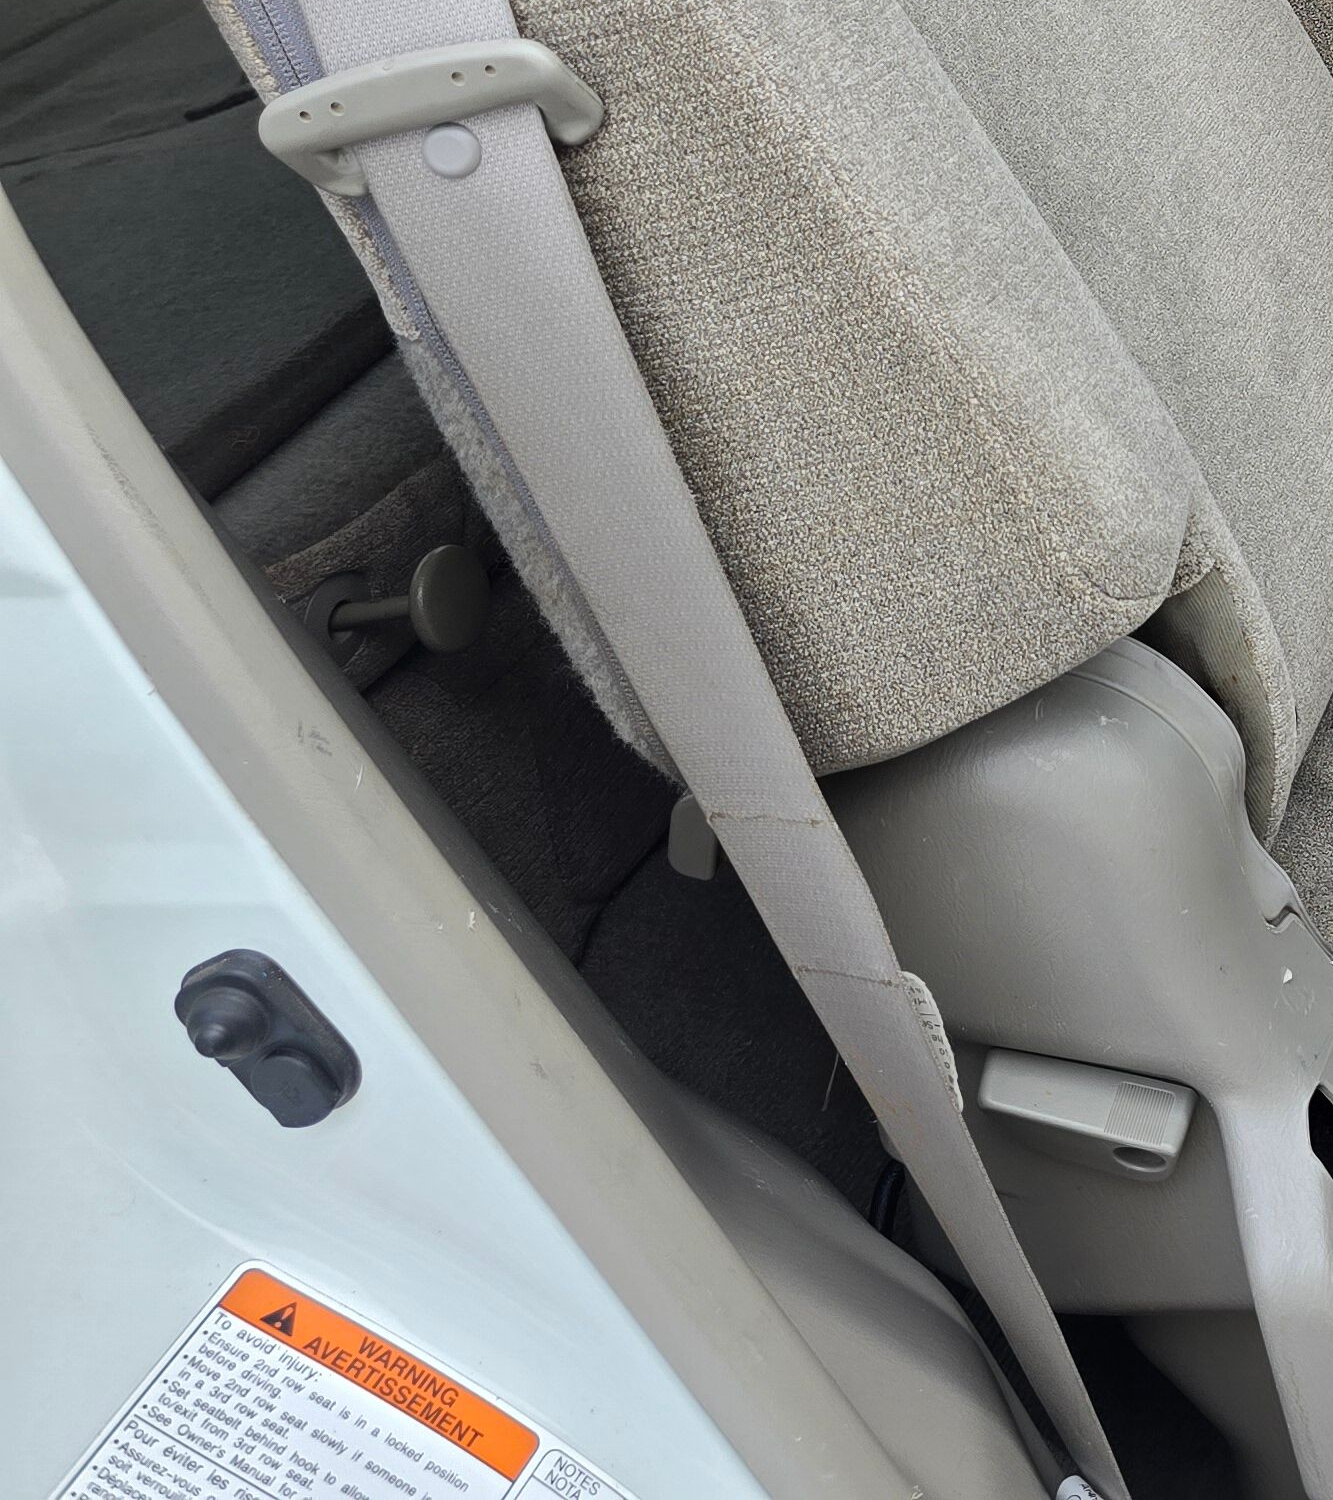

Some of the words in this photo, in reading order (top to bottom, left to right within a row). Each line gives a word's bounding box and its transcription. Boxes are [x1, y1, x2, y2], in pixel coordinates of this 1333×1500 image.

[197, 1342, 237, 1372] before
[240, 1369, 282, 1400] driving.
[213, 1311, 232, 1331] To
[236, 1330, 279, 1355] avoid
[278, 1349, 323, 1383] injury:
[358, 1336, 459, 1408] WARNING
[167, 1380, 191, 1401] Set
[192, 1398, 243, 1431] seatbelt
[243, 1425, 289, 1456] behind
[288, 1450, 321, 1476] hook
[322, 1471, 337, 1486] to
[177, 1366, 192, 1382] in
[194, 1379, 205, 1390] a
[208, 1385, 233, 1405] 3rd
[233, 1402, 259, 1420] row
[260, 1417, 290, 1440] seat.
[187, 1355, 222, 1382] Move
[223, 1378, 252, 1398] 2nd
[252, 1395, 277, 1413] row
[279, 1411, 309, 1431] seat
[310, 1428, 349, 1456] slowly
[350, 1450, 364, 1463] if
[364, 1460, 417, 1497] someone
[207, 1331, 250, 1362] Ensure
[252, 1358, 281, 1378] 2nd
[280, 1375, 306, 1394] row
[308, 1391, 337, 1412] seat
[338, 1405, 352, 1421] is
[353, 1414, 368, 1430] in
[370, 1427, 381, 1438] a
[383, 1432, 425, 1463] locked
[423, 1460, 470, 1493] position
[302, 1336, 485, 1448] AVERTISSEMENT
[122, 1419, 160, 1448] Pour
[162, 1444, 204, 1474] éviter
[205, 1468, 230, 1491] les
[147, 1405, 173, 1427] See
[176, 1423, 227, 1459] Owner's
[228, 1453, 277, 1487] Manual
[277, 1481, 298, 1500] for
[157, 1392, 199, 1423] to/exit
[199, 1417, 230, 1441] from
[233, 1436, 257, 1456] 3rd
[257, 1452, 283, 1471] row
[285, 1468, 314, 1491] seat.
[553, 1455, 601, 1496] NOTES
